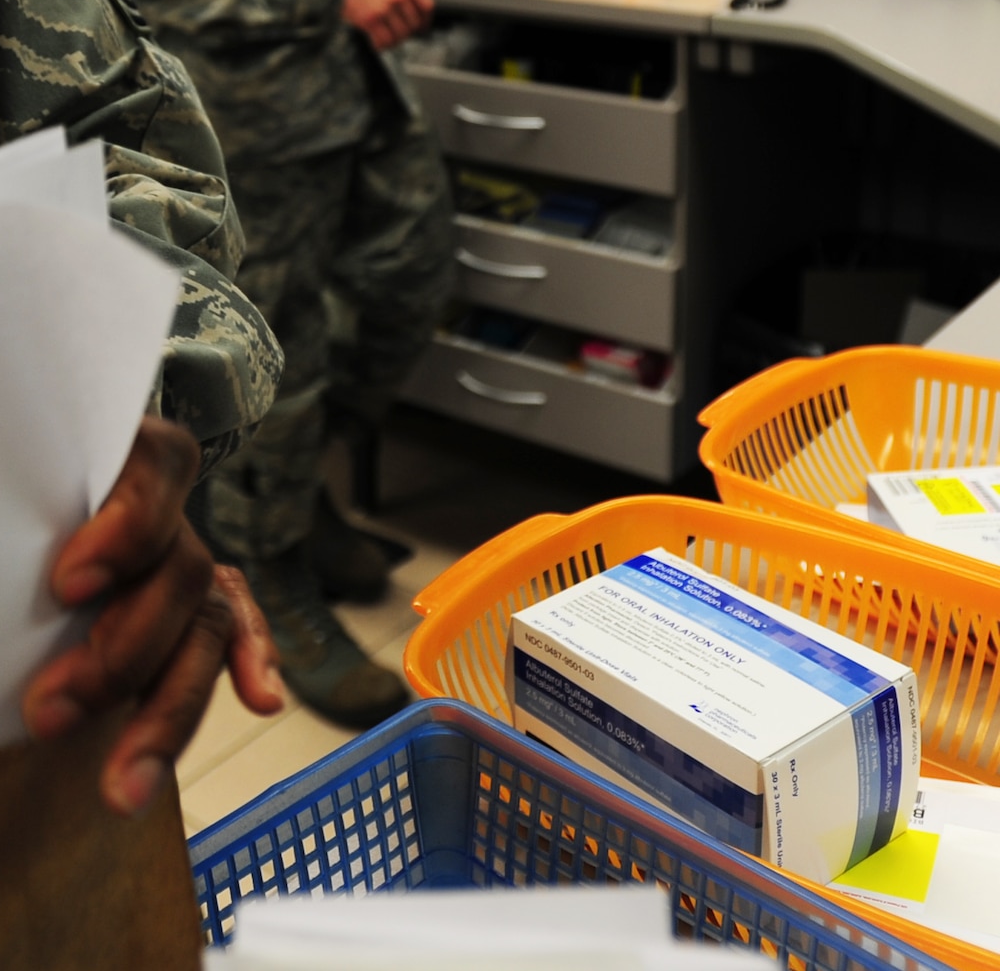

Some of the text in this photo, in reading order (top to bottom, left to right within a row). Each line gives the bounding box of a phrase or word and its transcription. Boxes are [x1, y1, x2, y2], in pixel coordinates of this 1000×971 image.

[640, 565, 683, 588] Inhalation
[648, 561, 688, 581] Albuterol
[688, 573, 721, 597] Sulfate
[525, 632, 542, 649] NDC
[598, 585, 746, 665] FOR ORAL INHALATION ONLY
[525, 659, 594, 708] Albuterol Sulfate
[526, 670, 566, 701] Inhalation
[568, 697, 605, 729] Solution,
[907, 686, 915, 707] NDC
[789, 759, 796, 773] Rx
[771, 772, 778, 783] 30
[775, 802, 781, 817] mL
